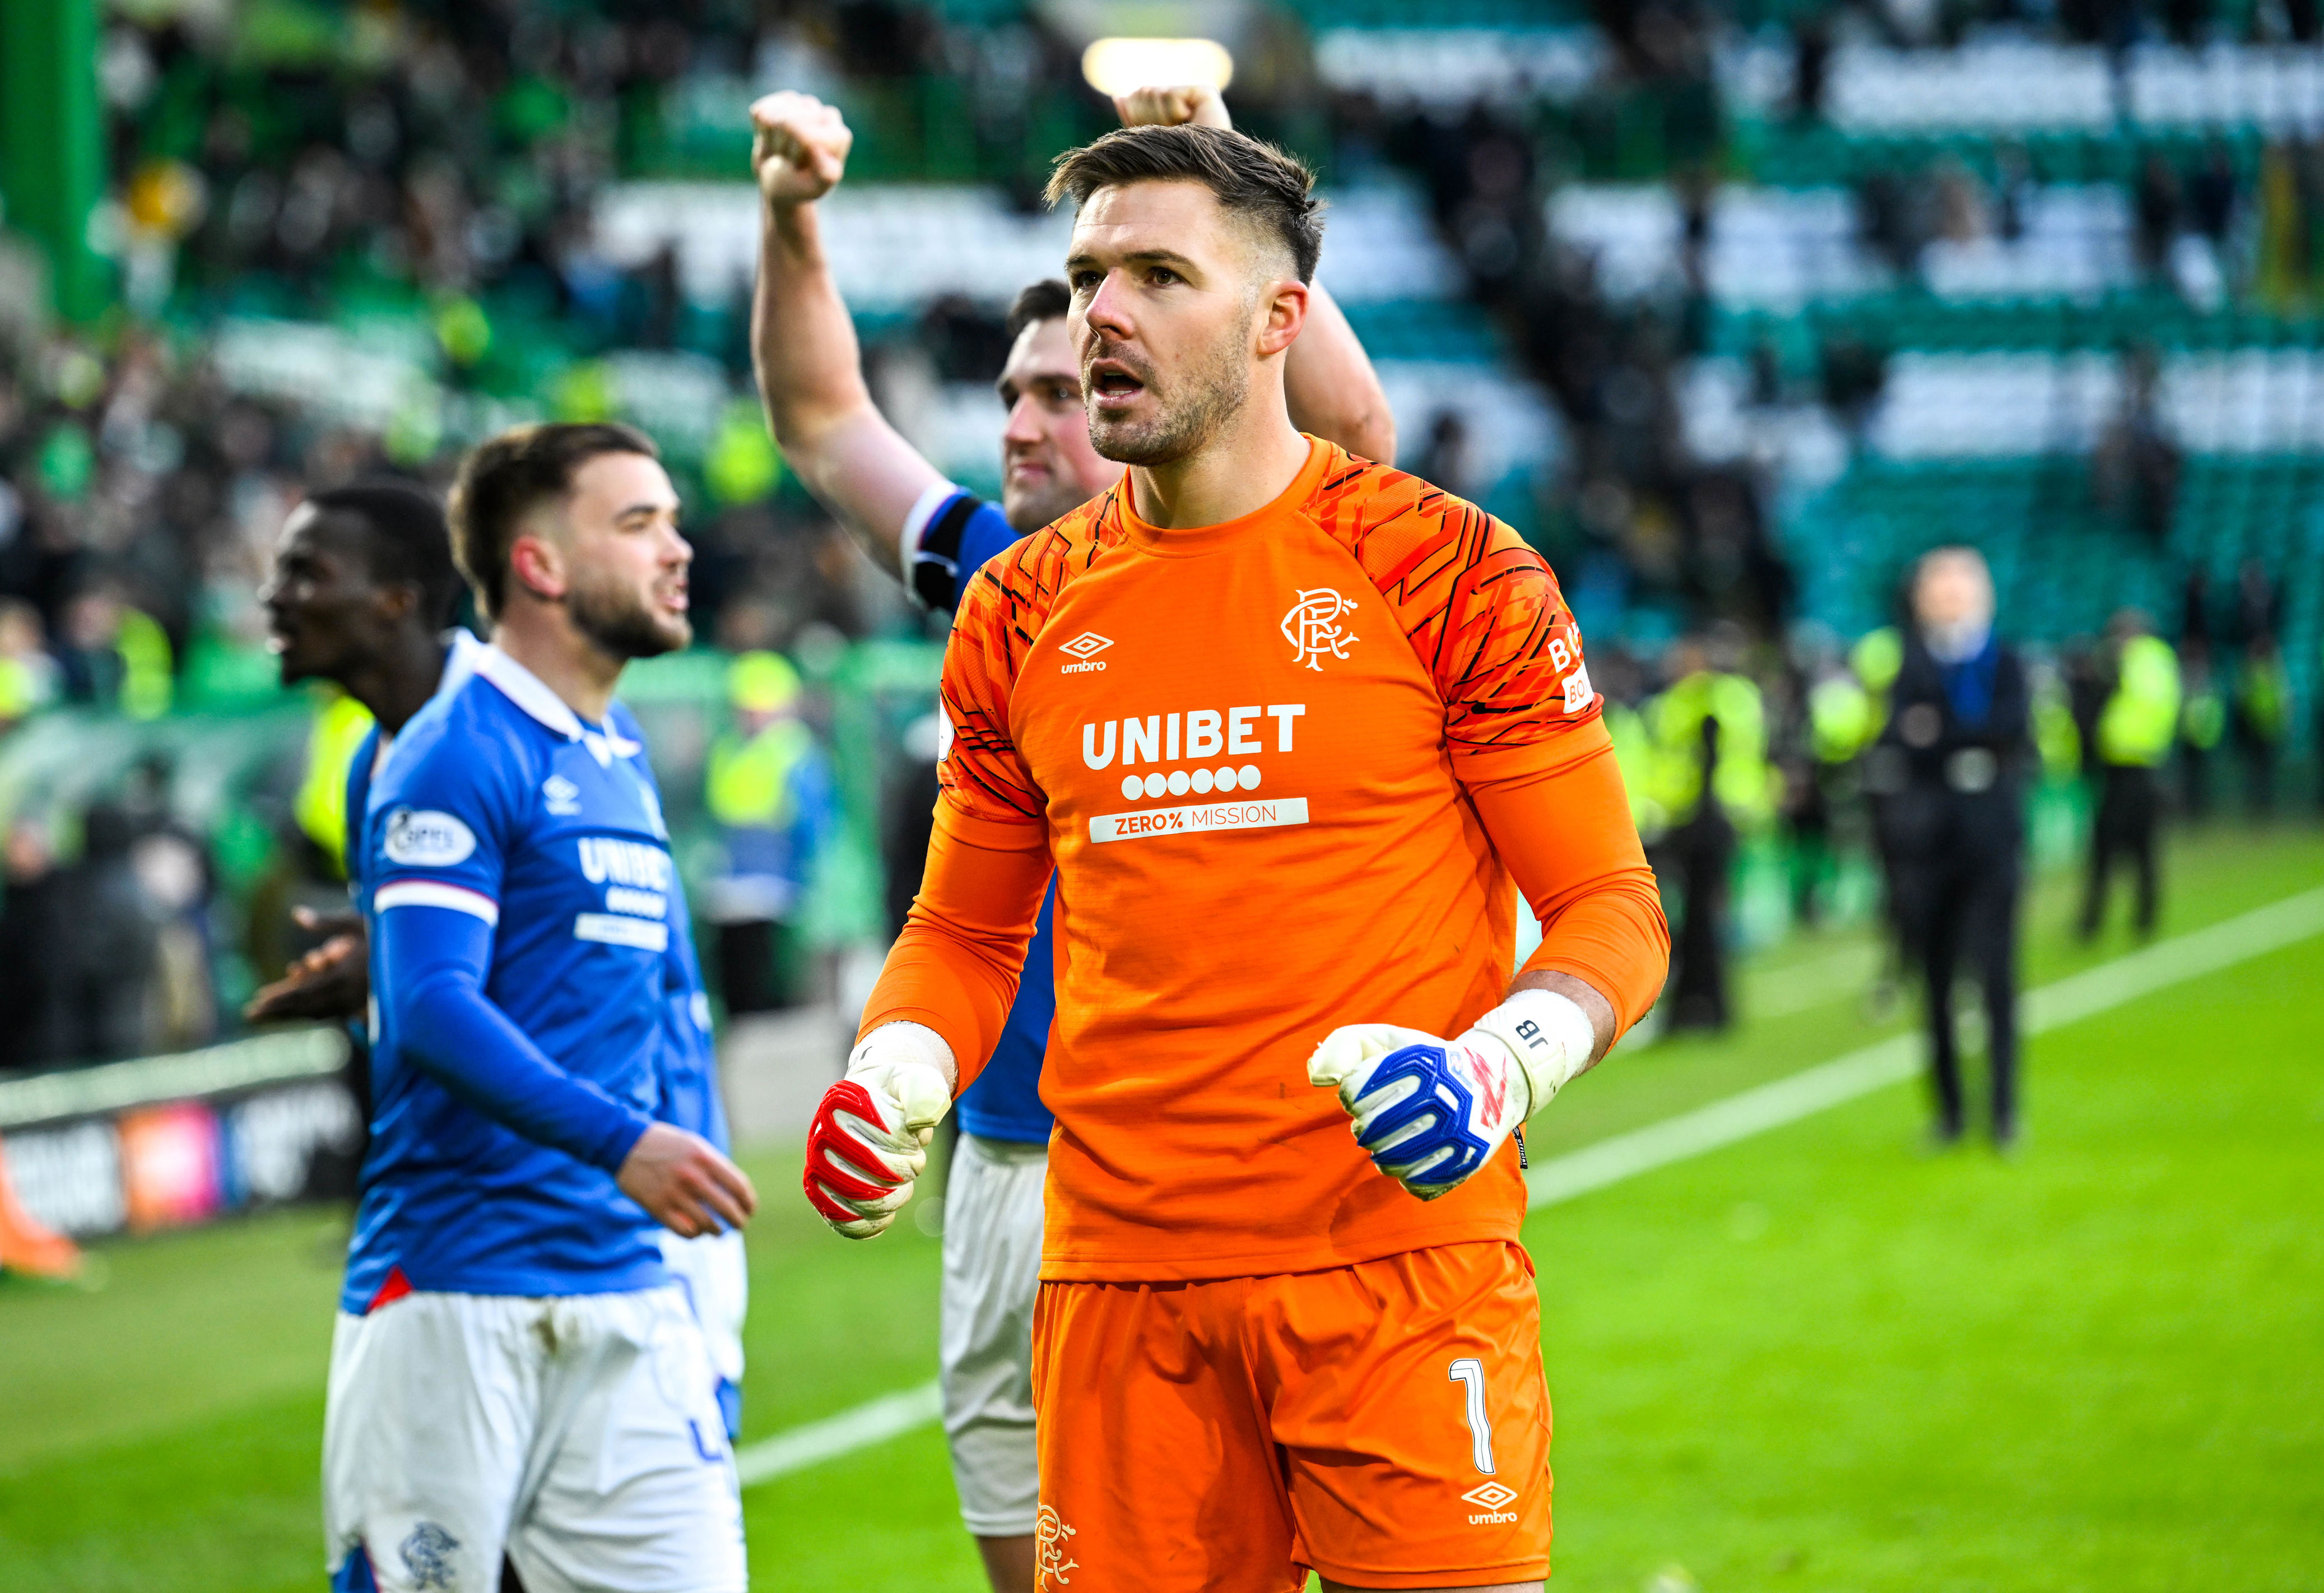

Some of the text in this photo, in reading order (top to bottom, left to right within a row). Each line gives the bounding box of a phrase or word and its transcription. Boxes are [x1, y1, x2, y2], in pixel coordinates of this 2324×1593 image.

[1061, 660, 1107, 674] umbro
[1082, 704, 1305, 770] UNIBET
[1115, 805, 1276, 835] ZERO% MISSION
[1516, 1020, 1549, 1049] JB
[1448, 1358, 1496, 1475] 1
[1468, 1511, 1518, 1525] umbro
